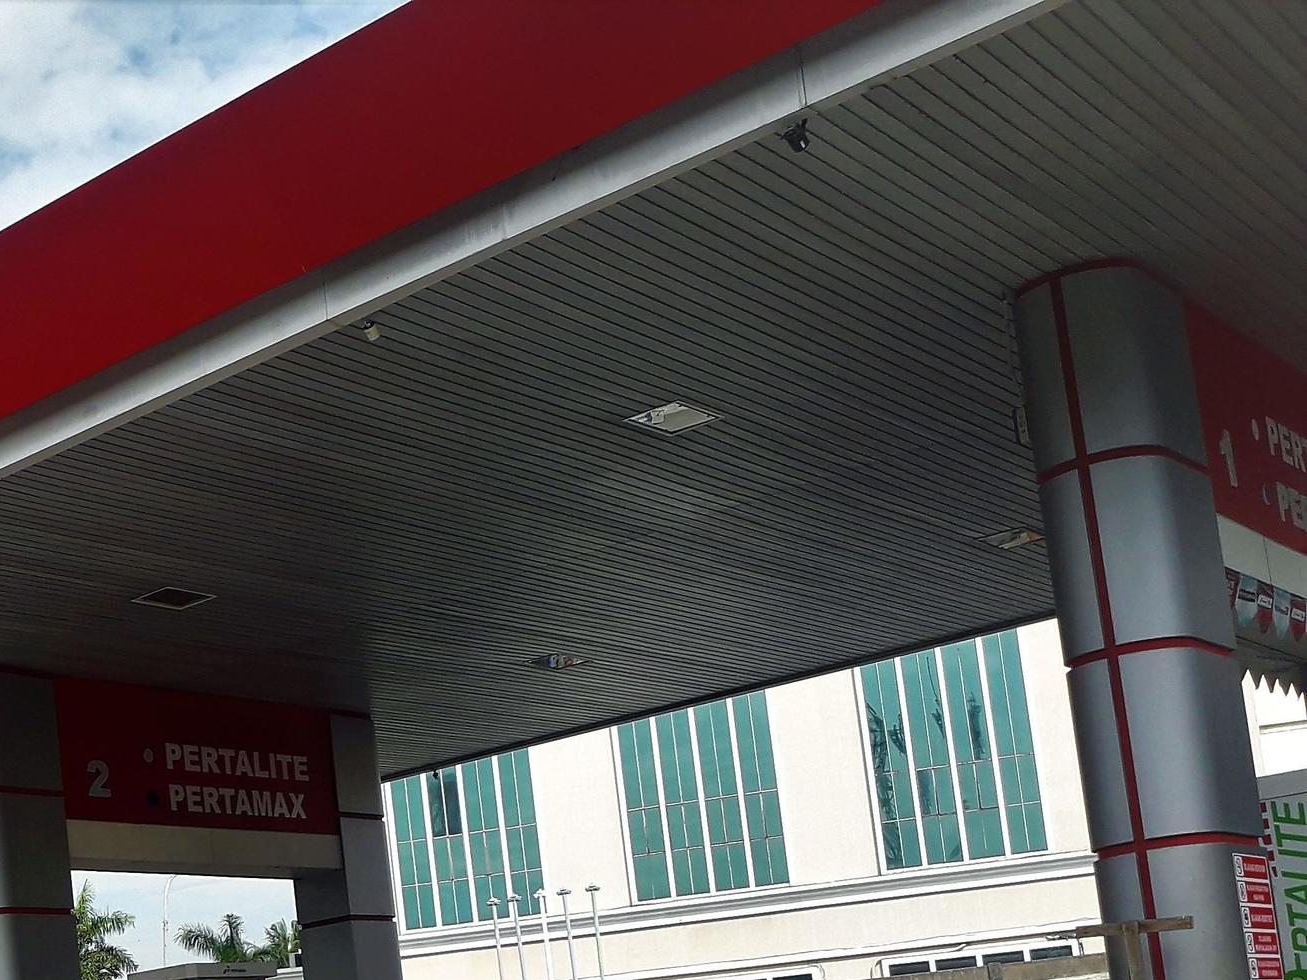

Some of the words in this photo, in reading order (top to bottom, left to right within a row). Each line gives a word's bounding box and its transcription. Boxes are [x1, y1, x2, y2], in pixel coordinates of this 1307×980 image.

[1220, 428, 1238, 488] 1
[86, 759, 112, 798] 2
[165, 742, 310, 782] PERTALITE
[168, 783, 308, 819] PERTAMAX
